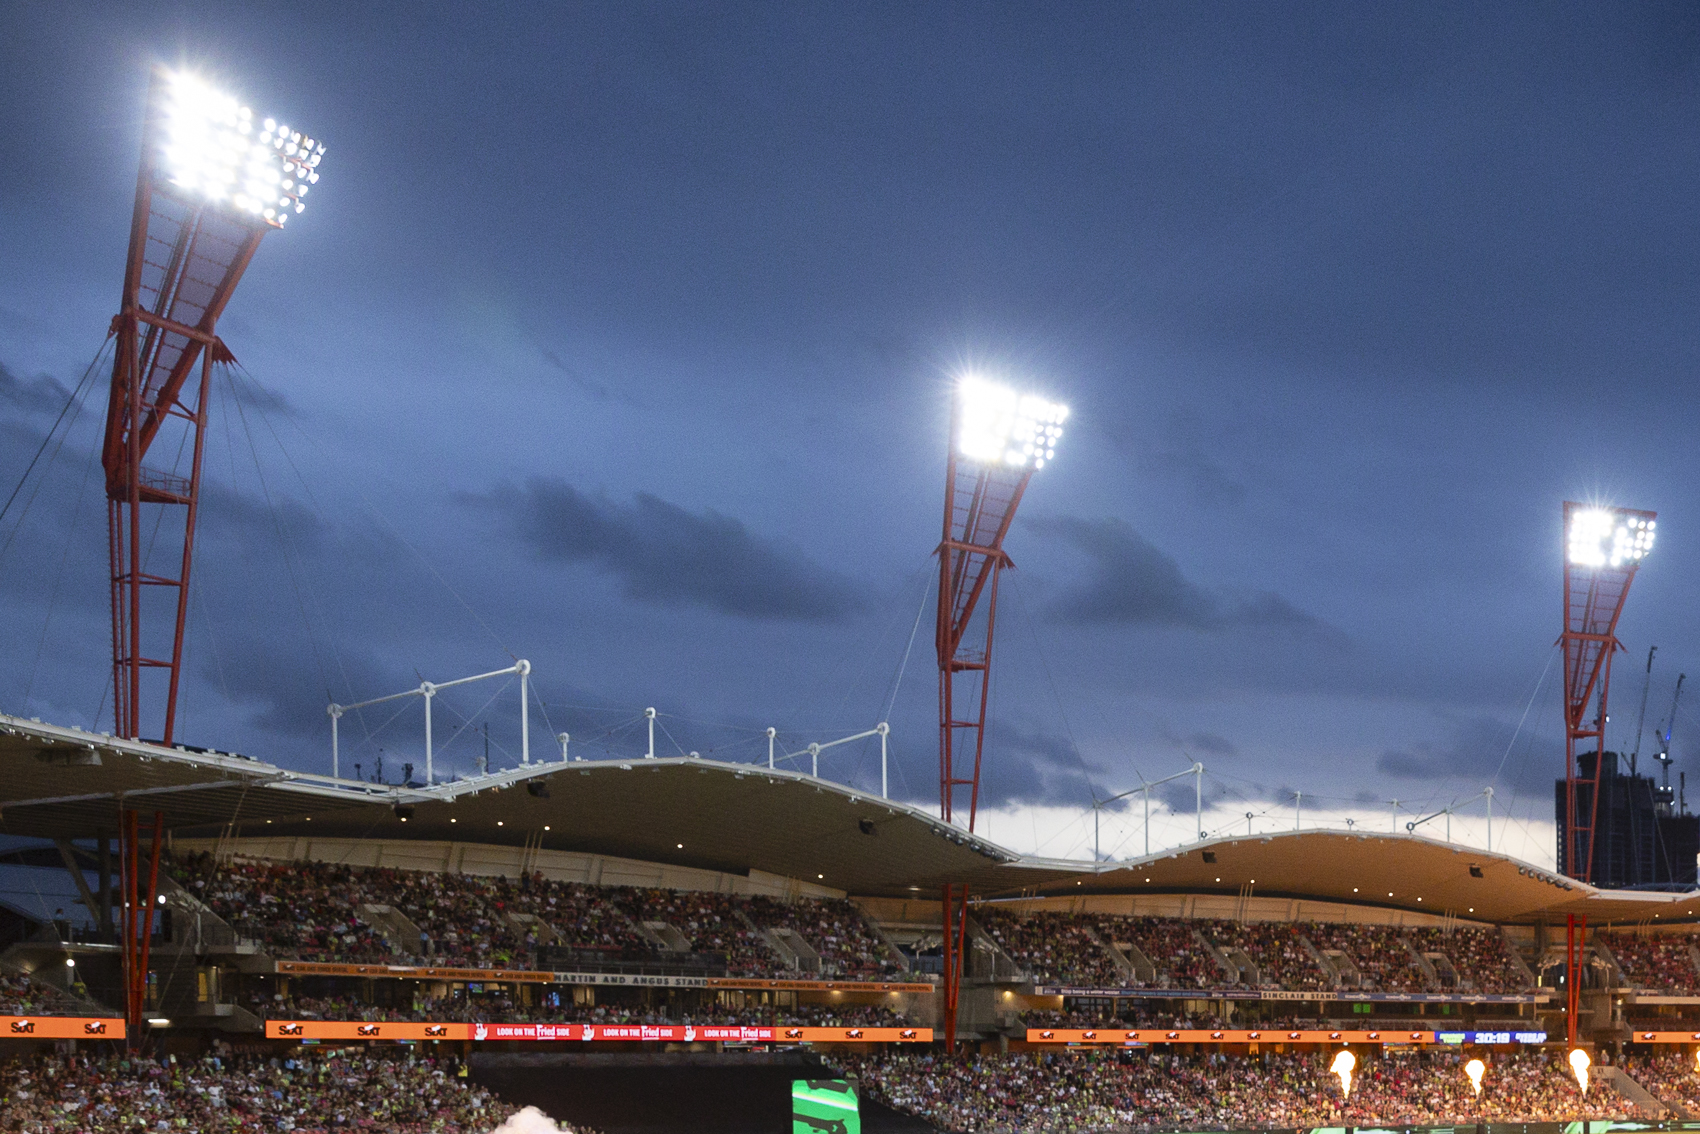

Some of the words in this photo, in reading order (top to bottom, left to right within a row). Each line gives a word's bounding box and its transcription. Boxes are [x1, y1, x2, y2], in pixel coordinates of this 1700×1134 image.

[554, 974, 596, 983] MARTIN
[603, 976, 626, 984] AND
[633, 977, 669, 986] ANGUS
[675, 978, 708, 987] STAND
[1263, 992, 1304, 1000] SINCLAIR
[497, 1027, 513, 1036] LOOK
[514, 1027, 523, 1036] ON
[523, 1027, 536, 1036] THE
[537, 1024, 556, 1037] Fried
[556, 1028, 570, 1037] SIDE
[603, 1028, 619, 1037] LOOK
[620, 1028, 629, 1037] ON
[630, 1028, 641, 1037] THE
[641, 1025, 659, 1038] Fried
[660, 1028, 673, 1037] SIDE
[704, 1029, 719, 1038] LOOK
[720, 1029, 728, 1038] ON
[729, 1029, 740, 1038] THE
[741, 1026, 758, 1038] Fried
[759, 1029, 771, 1038] SIDE
